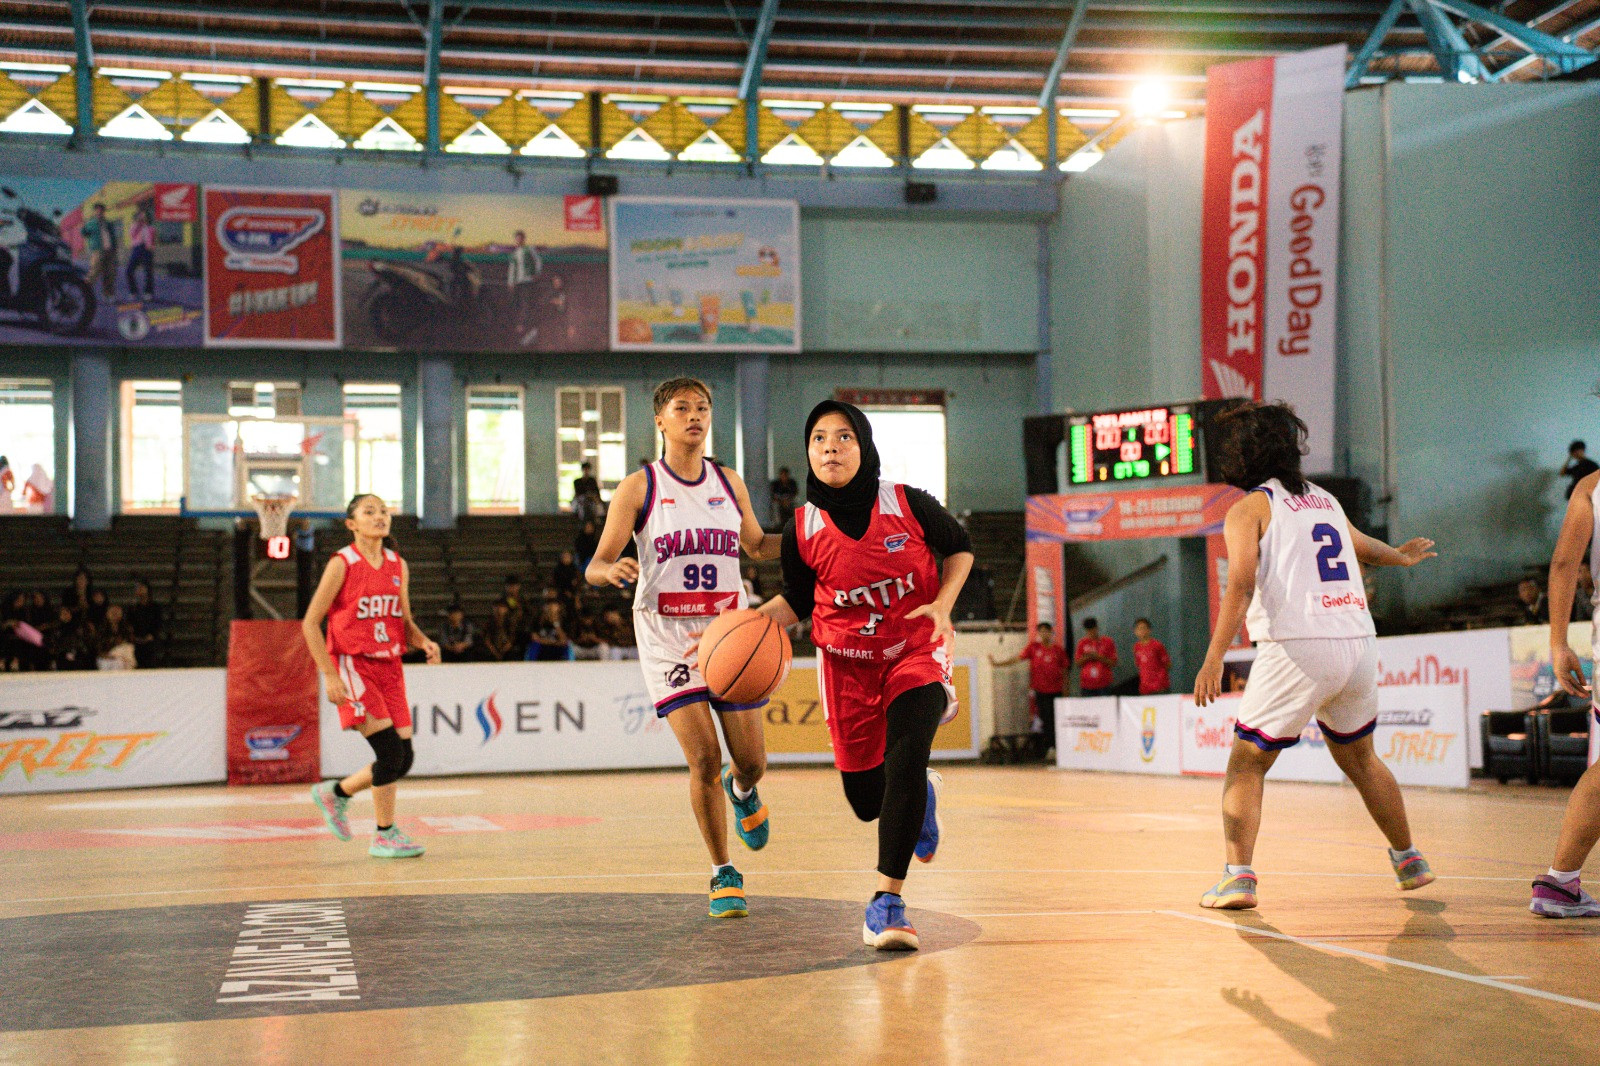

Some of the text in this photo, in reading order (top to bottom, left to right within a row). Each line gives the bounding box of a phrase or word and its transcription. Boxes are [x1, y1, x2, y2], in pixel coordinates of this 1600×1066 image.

[1227, 108, 1264, 356] HONDA
[1277, 184, 1326, 357] GoodDay
[654, 528, 740, 564] SMANDE
[1311, 523, 1350, 582] 2
[683, 563, 717, 590] 99
[662, 605, 679, 614] One
[826, 644, 842, 656] One
[1382, 729, 1457, 763] STREET
[216, 901, 361, 1003] AZAWEAR.COM
